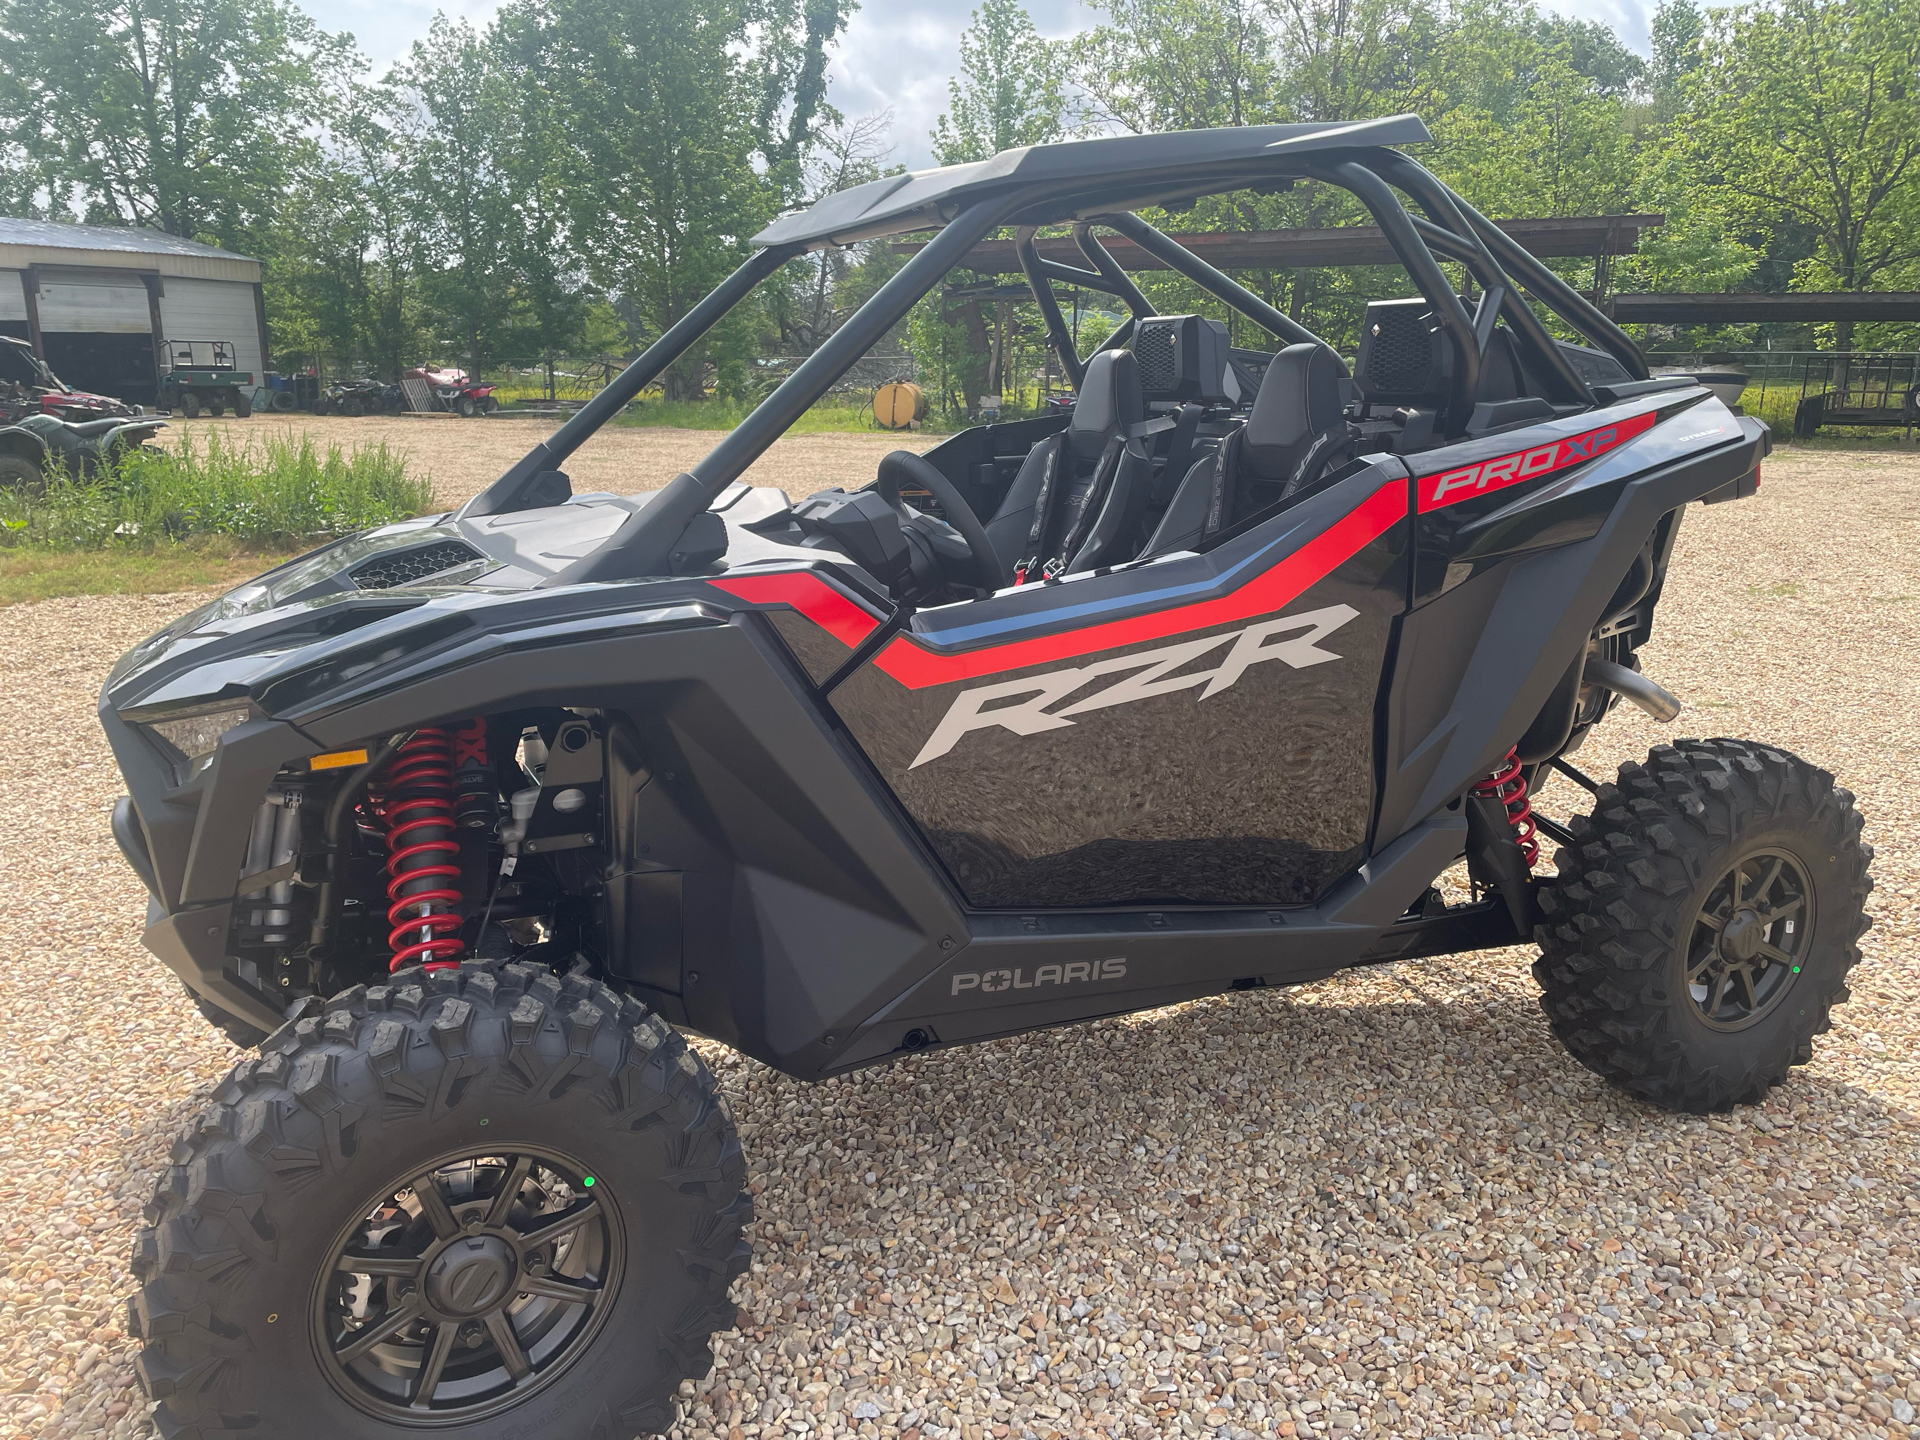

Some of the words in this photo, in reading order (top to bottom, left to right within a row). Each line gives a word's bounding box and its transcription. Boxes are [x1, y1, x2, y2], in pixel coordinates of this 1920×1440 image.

[1293, 432, 1328, 481] RZR
[1432, 444, 1560, 502] PRO
[1560, 428, 1617, 464] XP
[1211, 499, 1221, 526] ZERO
[907, 603, 1361, 770] RZR
[455, 716, 487, 768] OX
[951, 957, 1127, 996] POLARIS
